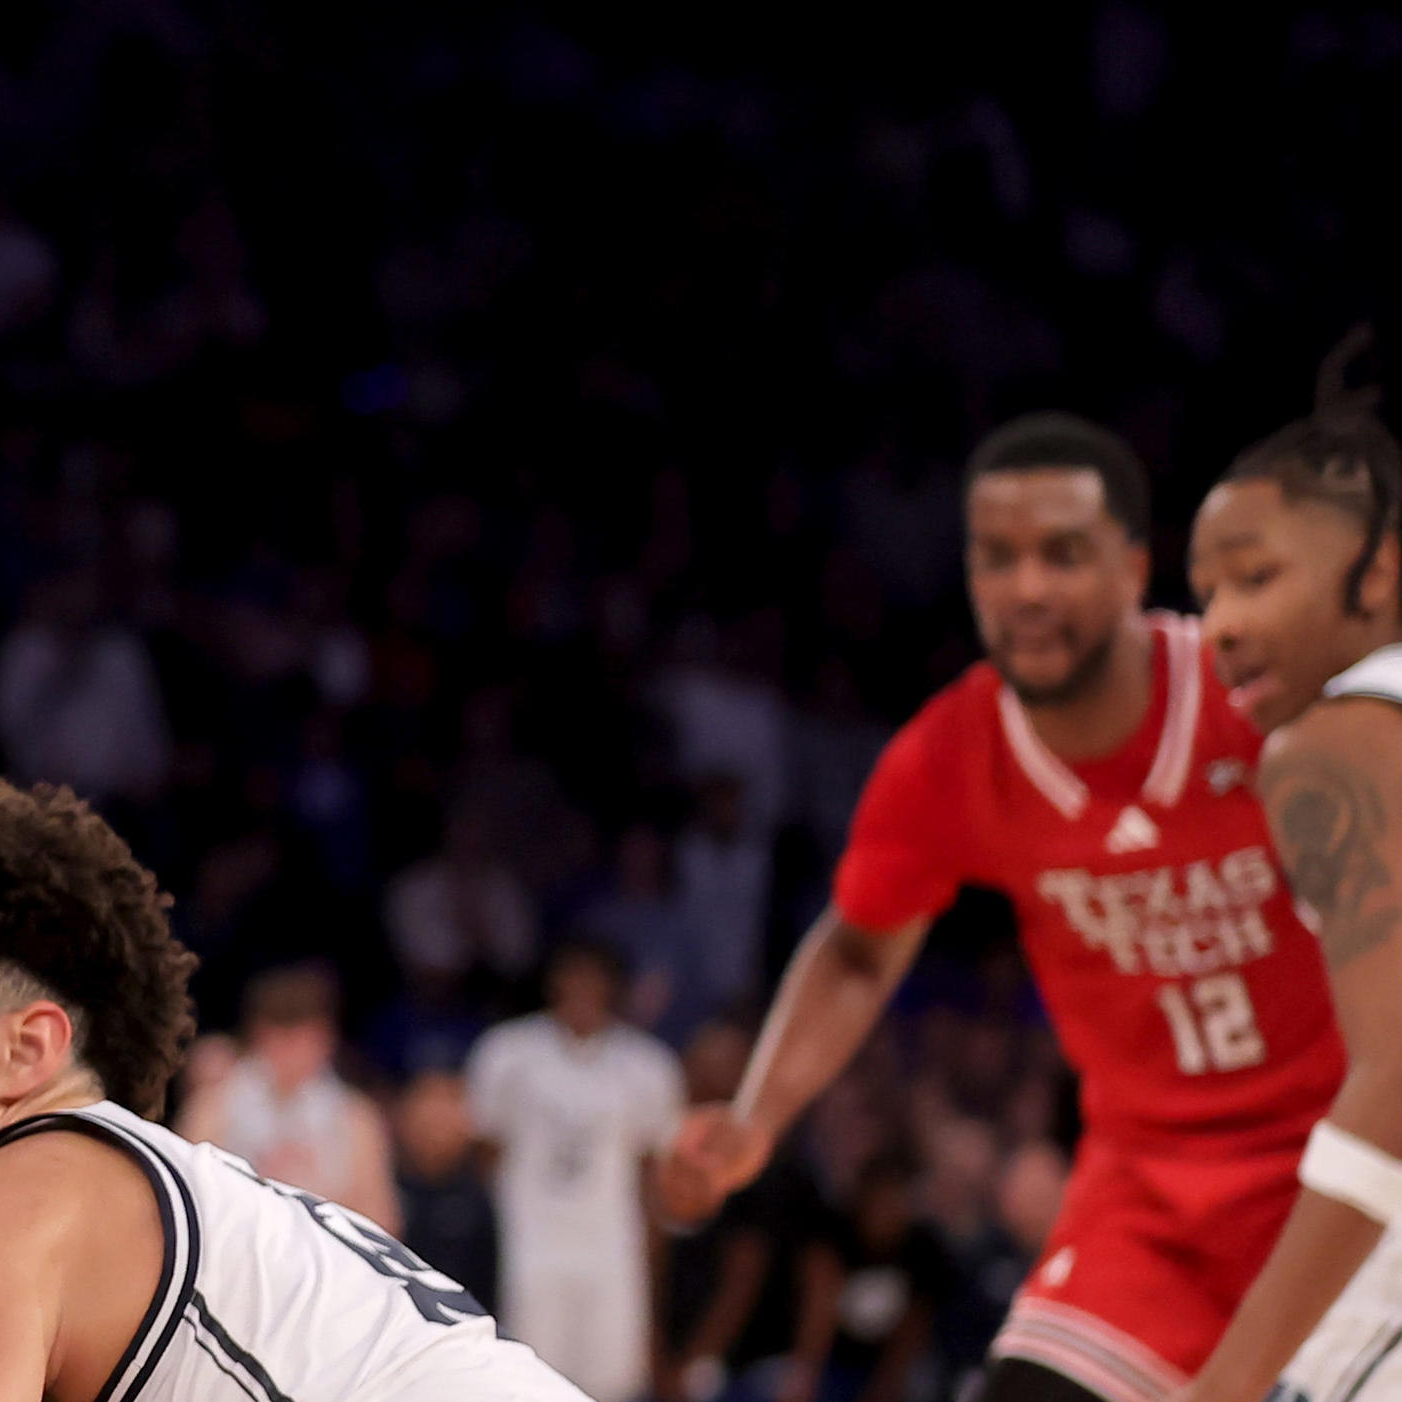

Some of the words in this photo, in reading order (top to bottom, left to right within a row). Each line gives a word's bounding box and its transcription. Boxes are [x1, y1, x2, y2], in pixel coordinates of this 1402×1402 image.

[1035, 845, 1278, 950] TEXAS
[1094, 898, 1275, 979] TECH
[1156, 970, 1266, 1076] 12
